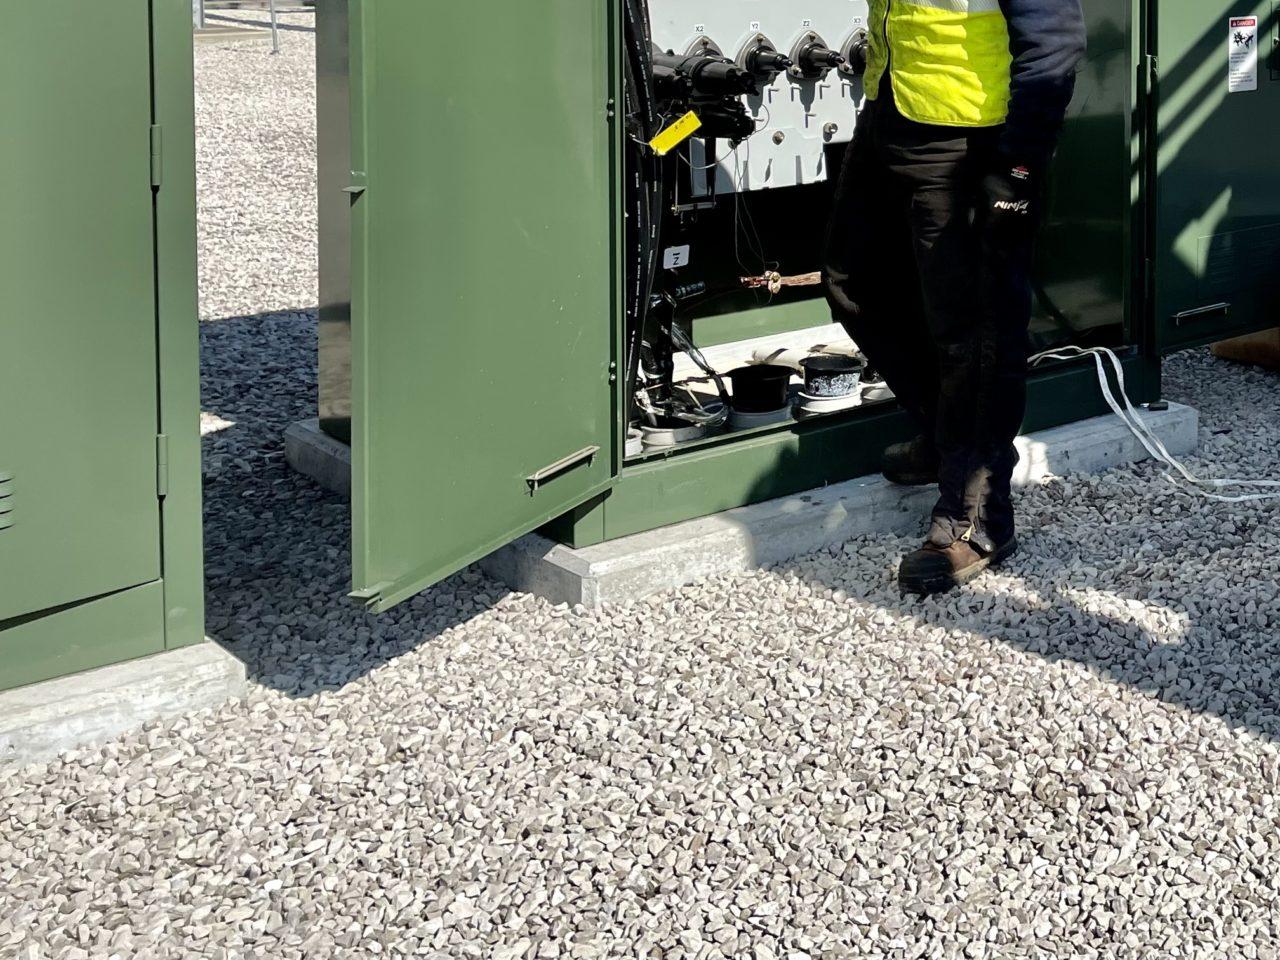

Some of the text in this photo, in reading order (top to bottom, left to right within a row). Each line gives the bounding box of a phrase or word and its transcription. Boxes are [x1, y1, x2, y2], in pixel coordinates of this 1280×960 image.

[695, 25, 704, 33] X2
[751, 22, 759, 31] Y2
[993, 200, 1030, 212] NINJA
